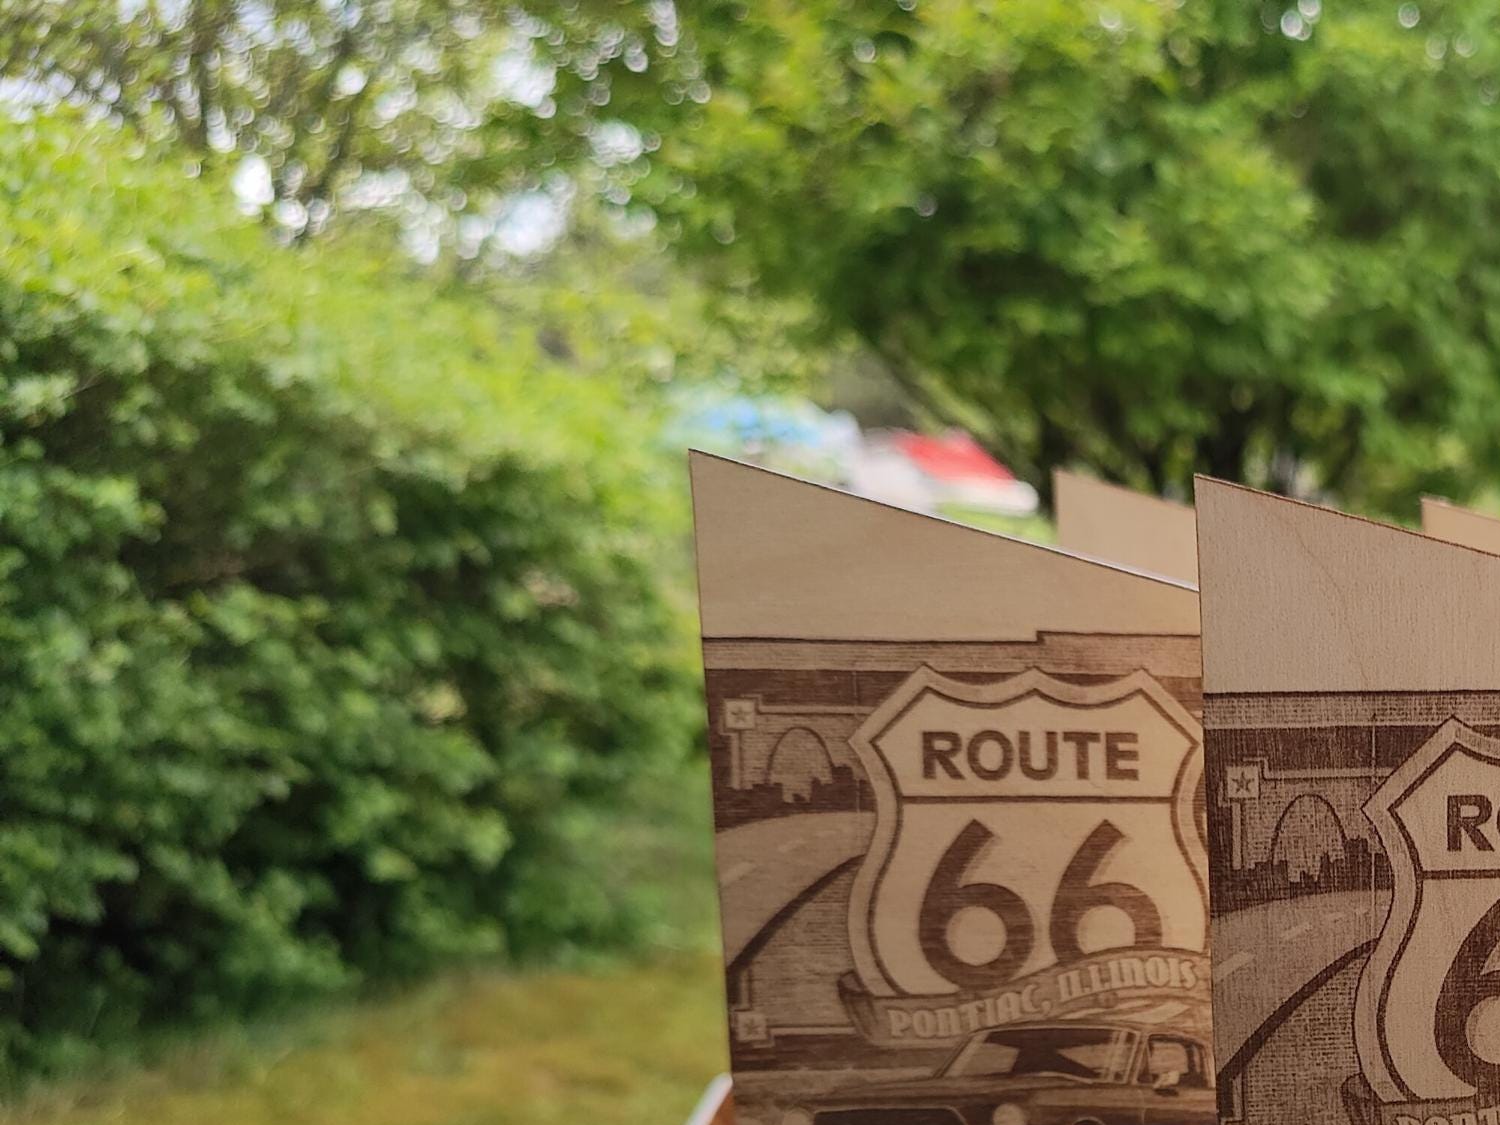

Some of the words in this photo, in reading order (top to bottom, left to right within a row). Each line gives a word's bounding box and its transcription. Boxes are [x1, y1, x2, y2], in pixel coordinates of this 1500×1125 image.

[922, 729, 1140, 782] ROUTE
[919, 818, 1163, 991] 66
[1056, 954, 1198, 999] ILLINOIS
